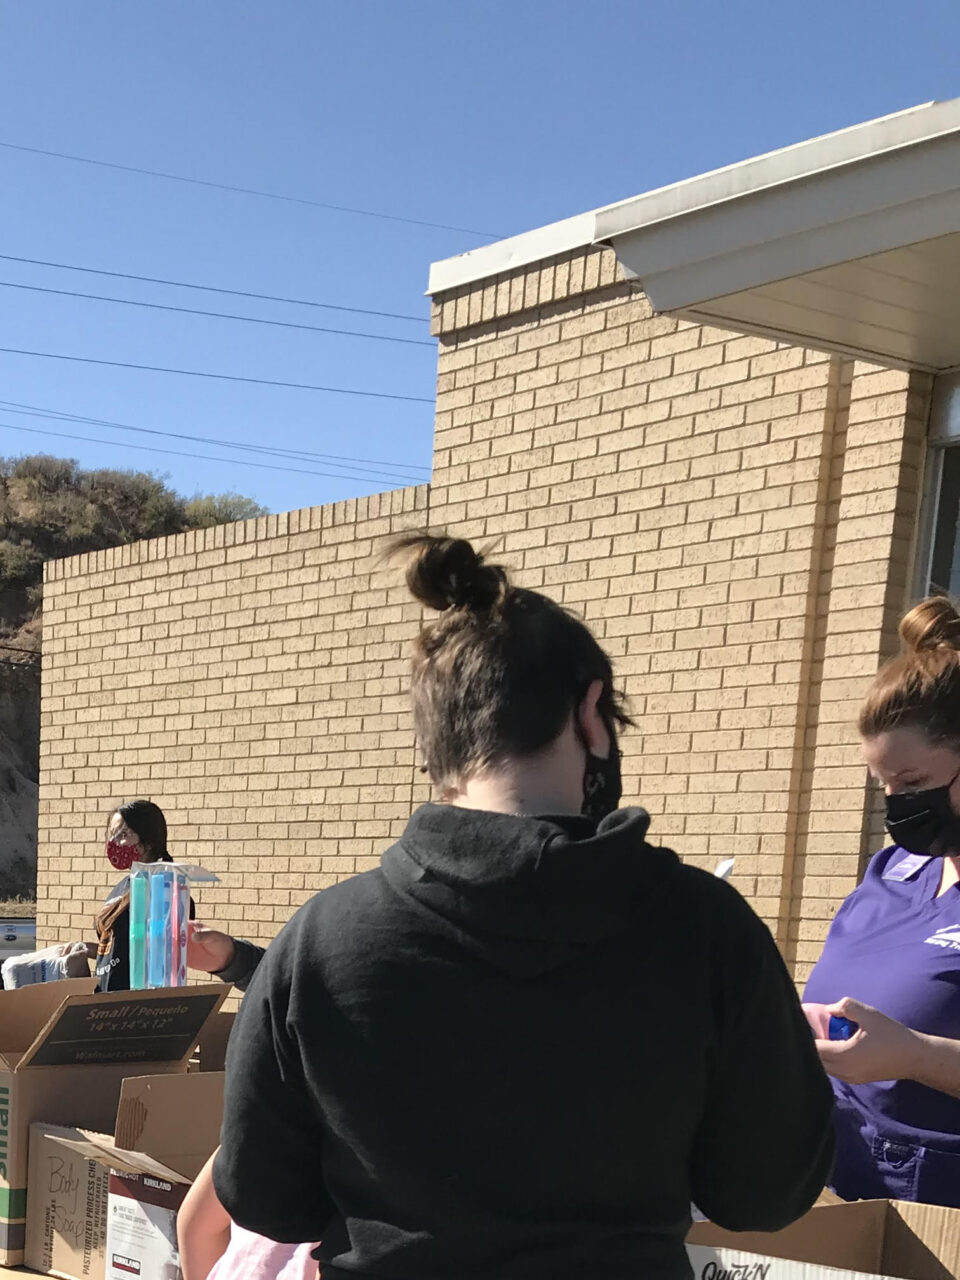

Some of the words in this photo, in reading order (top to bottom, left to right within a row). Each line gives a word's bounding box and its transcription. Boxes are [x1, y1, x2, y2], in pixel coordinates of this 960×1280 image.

[86, 1006, 130, 1020] Small
[48, 1156, 79, 1215] Body
[86, 1180, 95, 1219] PROCESS
[94, 1176, 102, 1228] REFRIGERATED
[143, 1177, 171, 1191] KIRKLAND
[54, 1205, 85, 1249] Soap
[83, 1220, 93, 1275] PASTEURIZED
[113, 1254, 140, 1270] KIRKLAND
